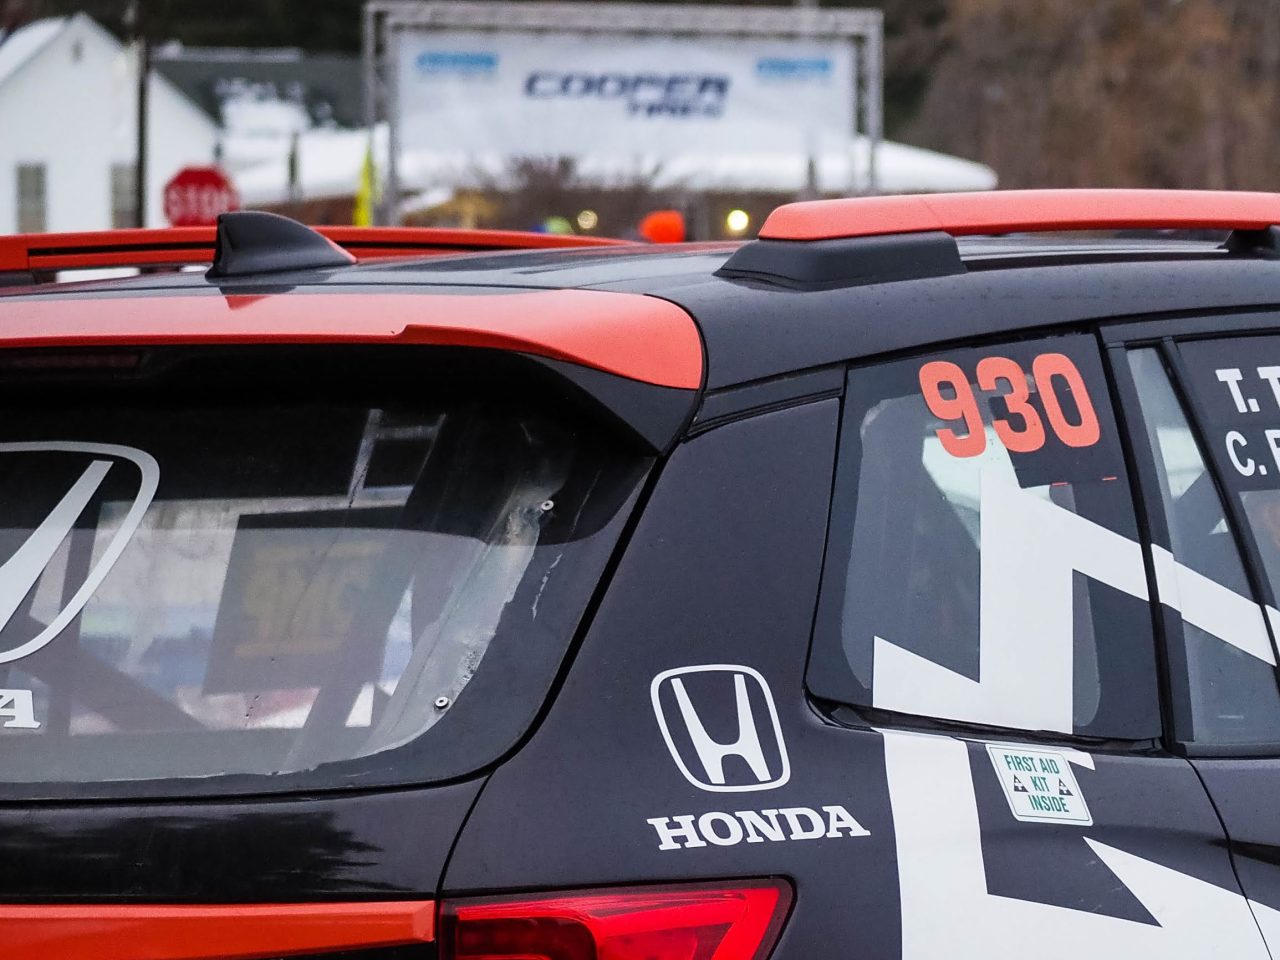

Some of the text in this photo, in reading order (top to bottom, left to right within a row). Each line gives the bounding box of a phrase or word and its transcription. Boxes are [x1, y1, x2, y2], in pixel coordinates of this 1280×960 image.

[524, 71, 730, 100] COOPER
[918, 352, 1101, 458] 930
[1214, 367, 1260, 413] T.
[1225, 430, 1268, 477] C.
[1004, 754, 1060, 774] FIRST AID
[1030, 775, 1050, 792] KIT
[1028, 794, 1070, 812] INSIDE
[646, 805, 871, 851] HONDA
